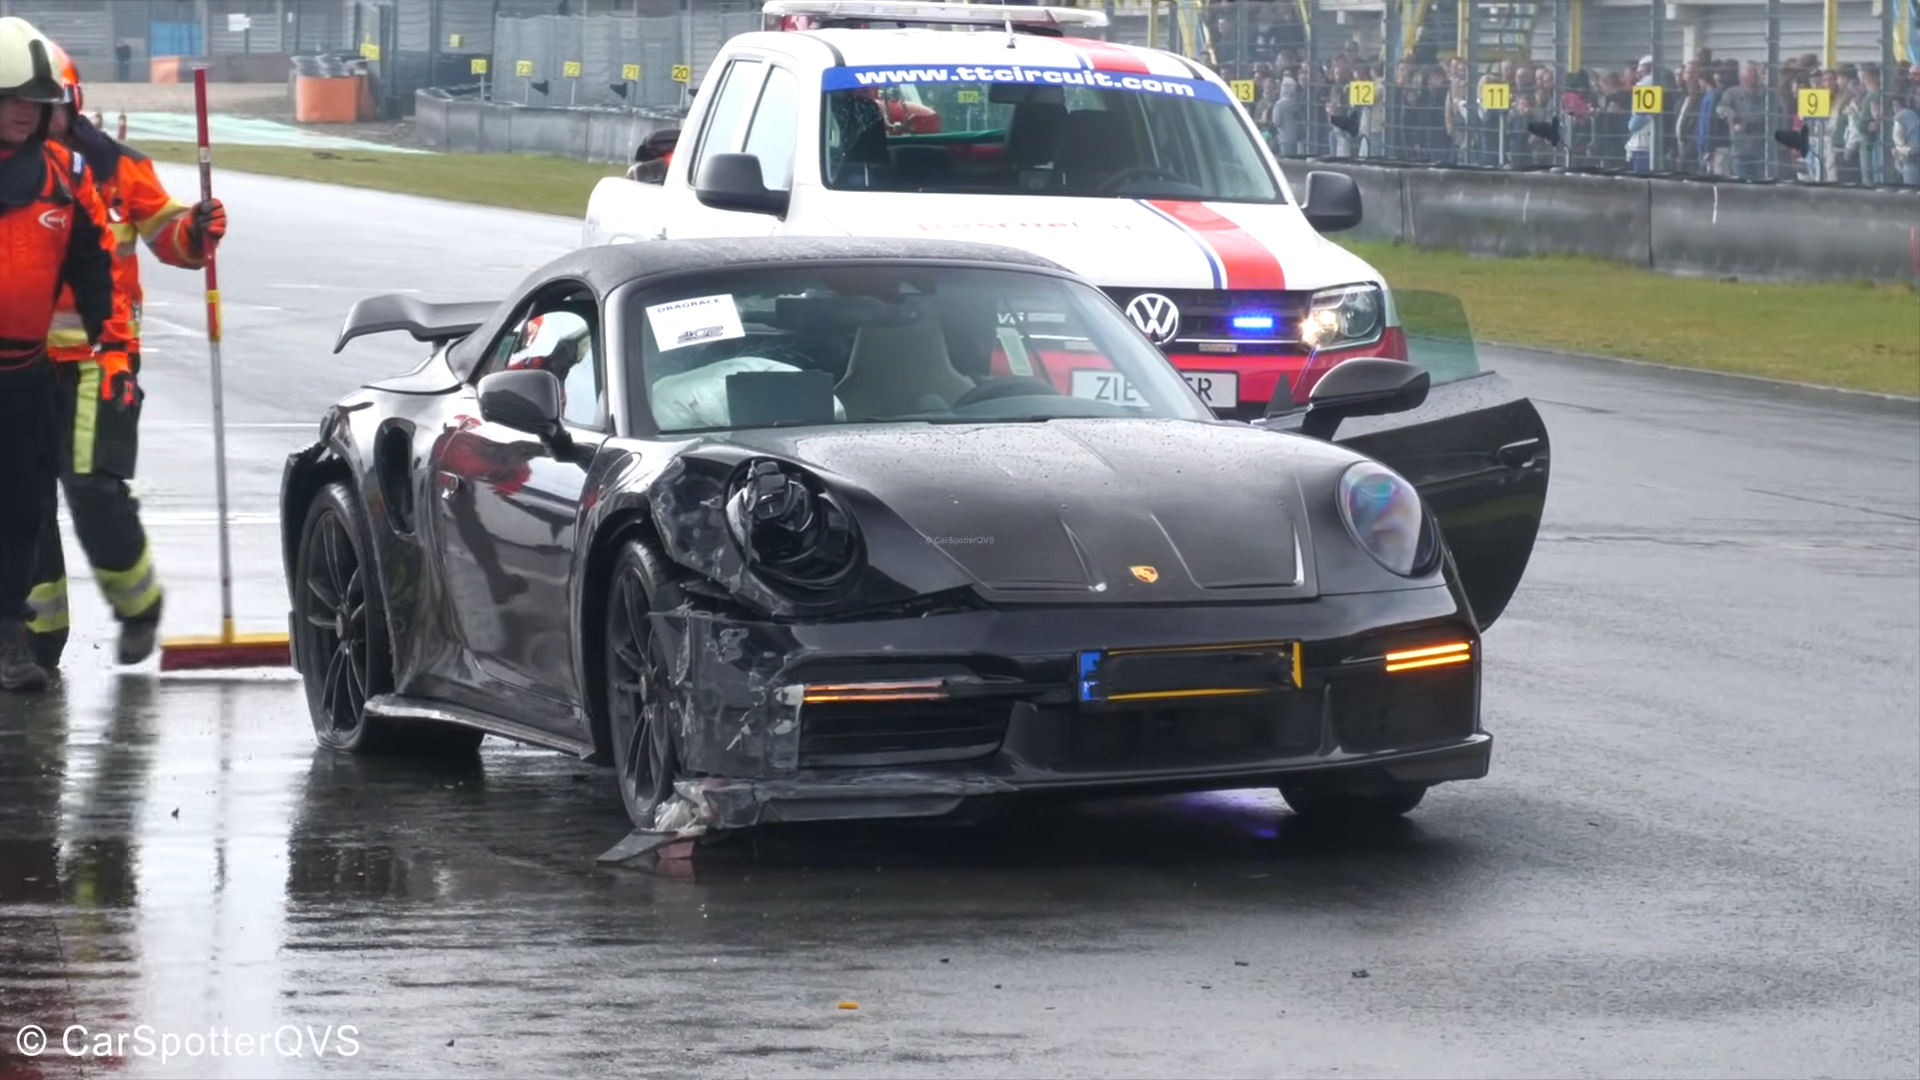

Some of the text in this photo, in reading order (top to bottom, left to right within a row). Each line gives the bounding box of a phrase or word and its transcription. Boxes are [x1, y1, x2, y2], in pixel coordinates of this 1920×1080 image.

[565, 63, 579, 76] 22
[624, 66, 638, 78] 21
[673, 66, 689, 80] 20
[855, 66, 1195, 97] www.ttcircuit.com
[1234, 83, 1251, 101] 13
[1354, 85, 1372, 103] 12
[1488, 88, 1504, 107] 11
[1634, 89, 1655, 110] 10
[1807, 92, 1818, 115] 9
[657, 298, 720, 313] DRAGRACE
